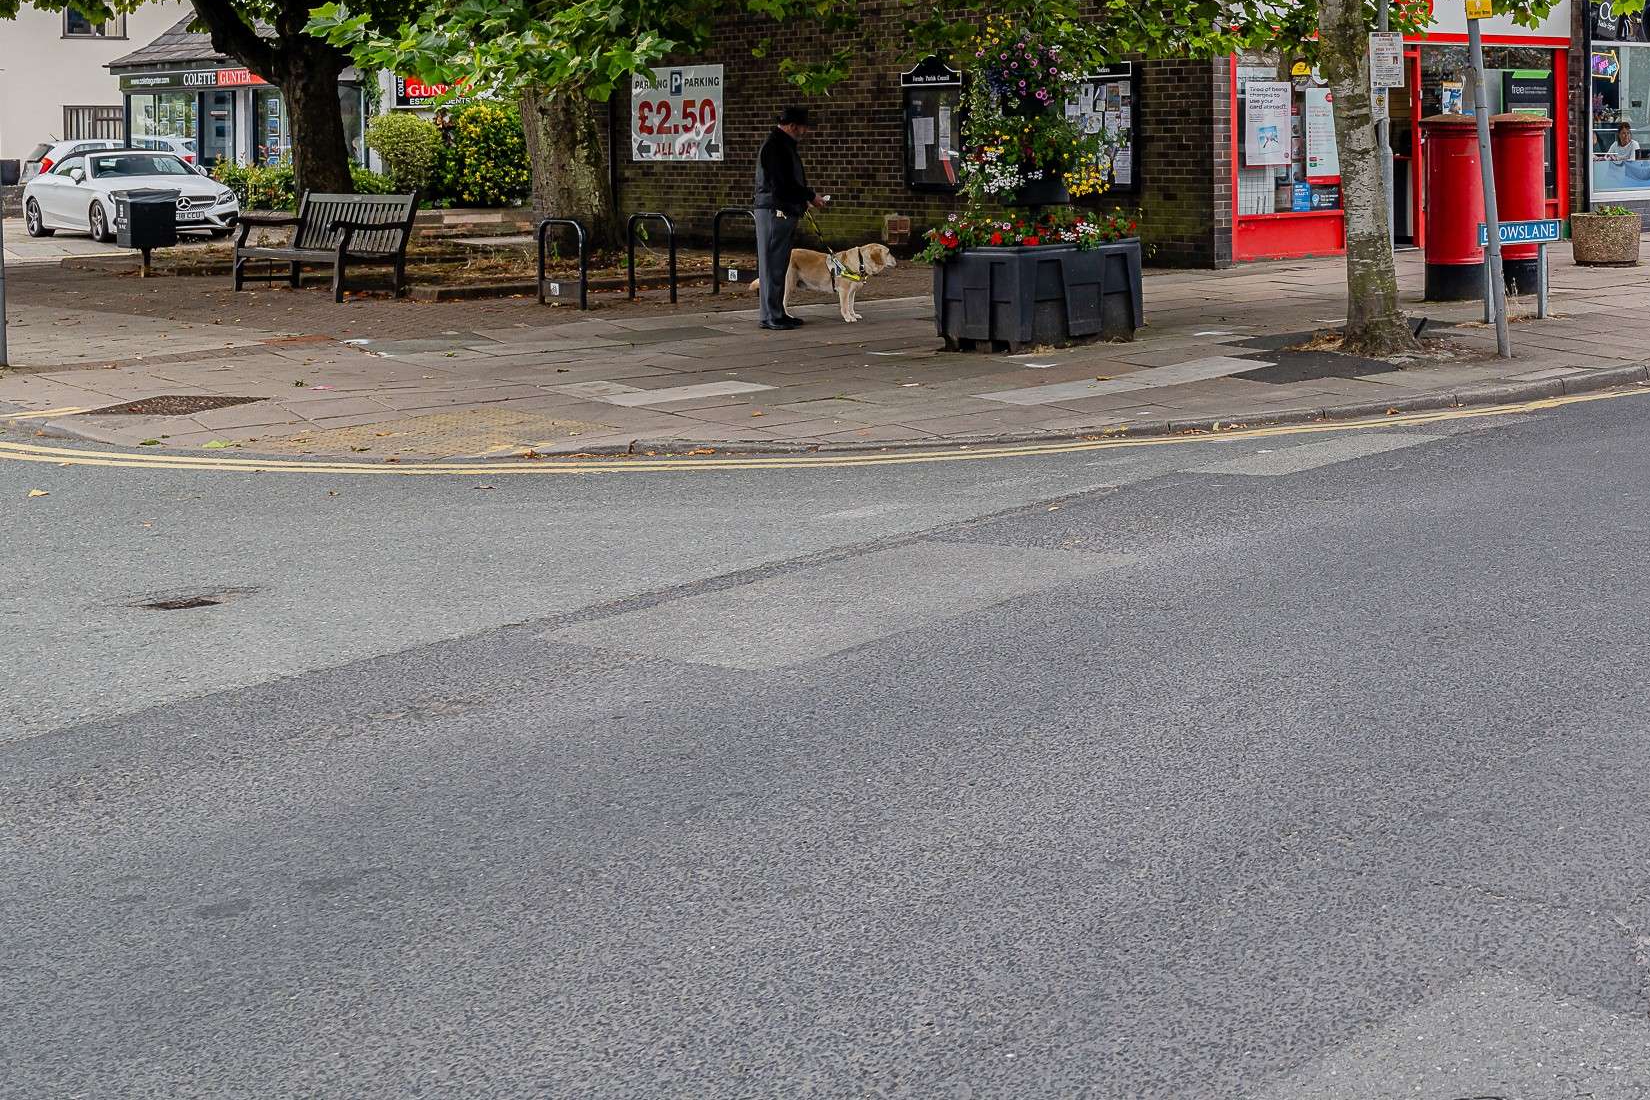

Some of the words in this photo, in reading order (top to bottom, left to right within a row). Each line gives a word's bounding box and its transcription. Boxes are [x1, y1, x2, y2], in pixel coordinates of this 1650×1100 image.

[183, 72, 216, 86] COLETTE
[219, 69, 251, 84] GUNTER
[634, 80, 668, 90] PARNG
[684, 77, 720, 87] PARKING
[1512, 85, 1524, 94] free
[638, 98, 716, 135] £2.50
[654, 142, 673, 156] ALL
